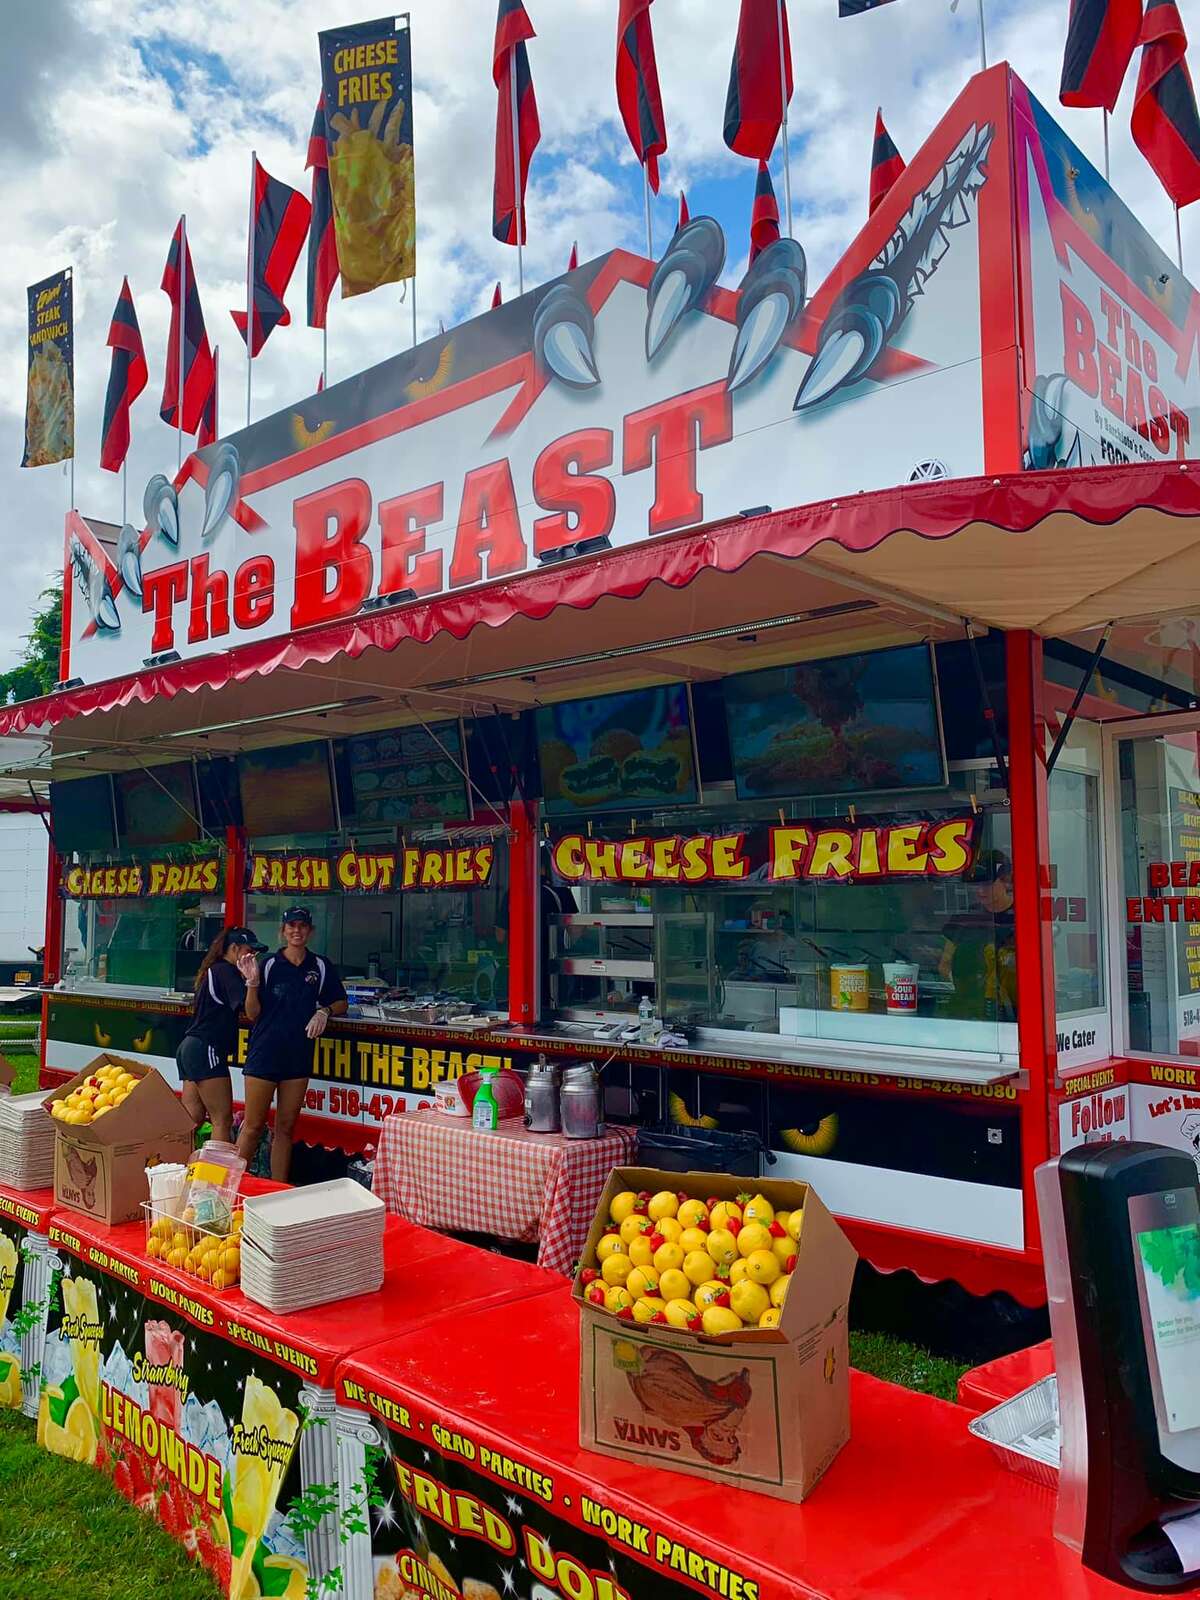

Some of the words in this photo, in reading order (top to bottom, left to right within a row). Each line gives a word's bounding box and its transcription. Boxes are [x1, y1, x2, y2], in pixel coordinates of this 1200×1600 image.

[334, 40, 398, 74] CHEESE
[338, 72, 393, 107] FRIES
[37, 305, 60, 327] STEAK
[1100, 287, 1158, 383] The
[1060, 280, 1190, 461] BEAST
[142, 553, 275, 653] The
[290, 380, 733, 630] BEAST
[250, 854, 331, 889] FRESH
[337, 850, 395, 888] CUT
[401, 846, 495, 889] FRIES
[552, 833, 750, 882] CHEESE
[770, 819, 974, 881] FRIES
[66, 867, 141, 897] CHEESE
[149, 858, 218, 896] FRIES
[891, 993, 915, 1001] CREAM
[894, 985, 913, 993] SOUR
[1072, 1030, 1096, 1049] Cater
[357, 1042, 405, 1087] THE
[1065, 1072, 1092, 1096] SPECIAL
[1091, 1068, 1114, 1090] EVENTS
[1151, 1065, 1196, 1085] WORK
[1071, 1094, 1126, 1137] Follow
[1148, 1094, 1182, 1118] Let's
[16, 1205, 40, 1226] EVENTS
[61, 1231, 81, 1252] CATER
[89, 1247, 108, 1268] GRAD
[109, 1257, 139, 1286] PARTIES
[149, 1278, 177, 1305] WORK
[178, 1296, 214, 1326] PARTIES
[227, 1320, 273, 1354] SPECIAL
[274, 1340, 318, 1376] EVENTS
[131, 1351, 190, 1405] Strawberry
[100, 1382, 223, 1512] LEMONADE
[231, 1423, 260, 1456] Fresh
[614, 1420, 682, 1451] SANTA
[343, 1379, 367, 1403] WE
[368, 1391, 412, 1430] CATER
[430, 1422, 477, 1461] GRAD
[479, 1445, 553, 1502] PARTIES
[580, 1495, 650, 1555] WORK
[655, 1534, 759, 1600] PARTIES
[394, 1459, 514, 1551] FRIED
